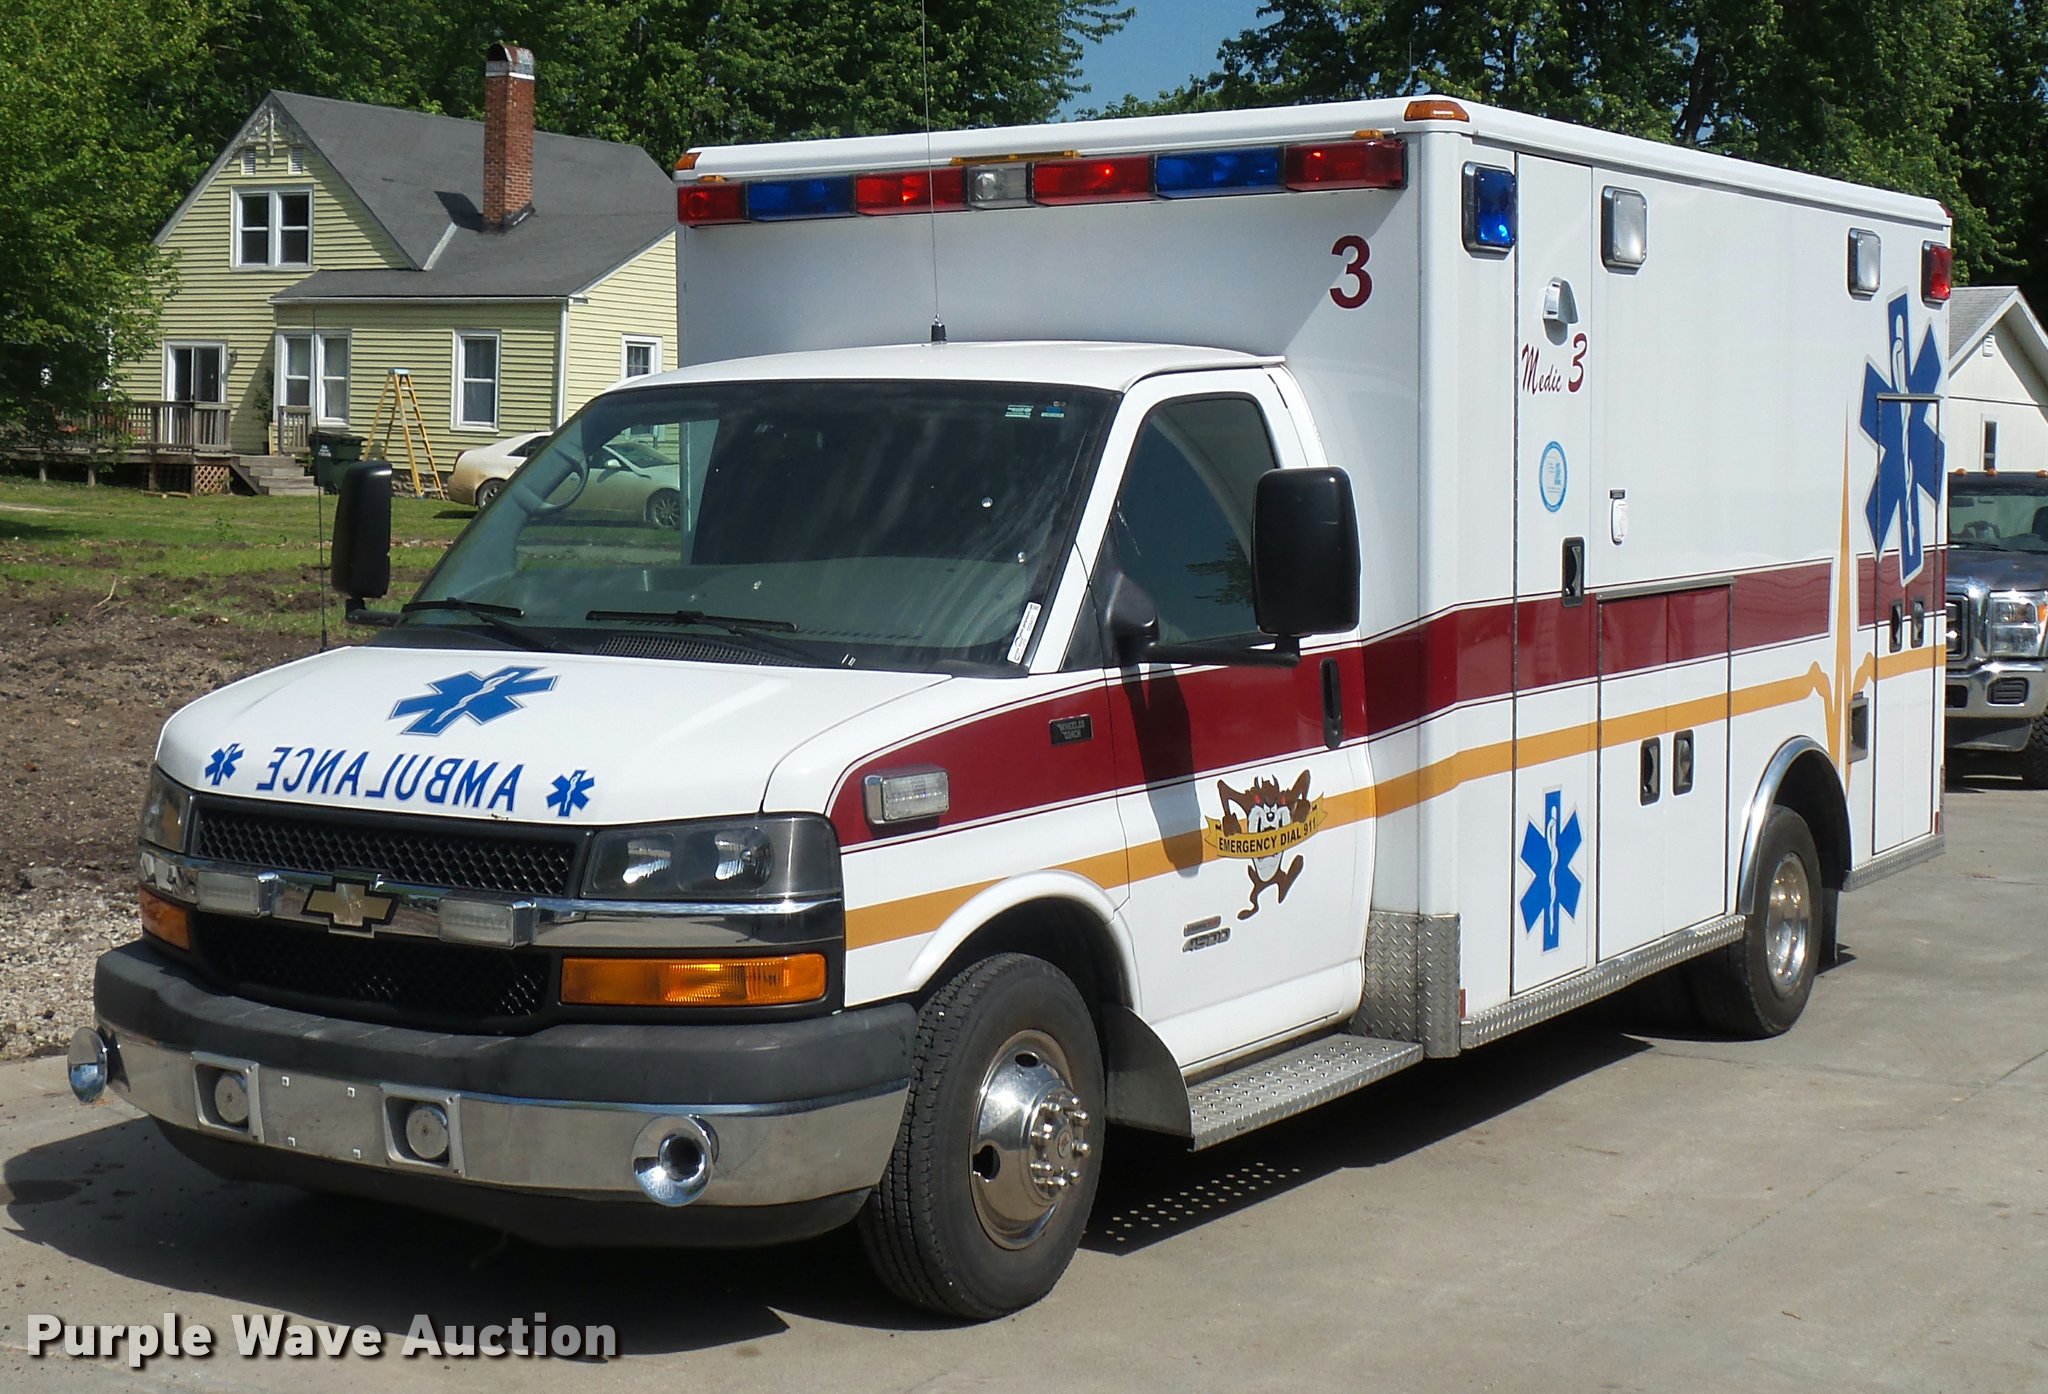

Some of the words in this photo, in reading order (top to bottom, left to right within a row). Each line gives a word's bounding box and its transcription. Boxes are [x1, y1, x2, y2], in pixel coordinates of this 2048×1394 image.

[1329, 234, 1373, 309] 3
[1521, 342, 1562, 395] Medic
[1567, 332, 1588, 393] 3
[1218, 836, 1278, 854] EMERGENCY
[1280, 826, 1302, 846] DIAL
[1303, 816, 1317, 836] 911
